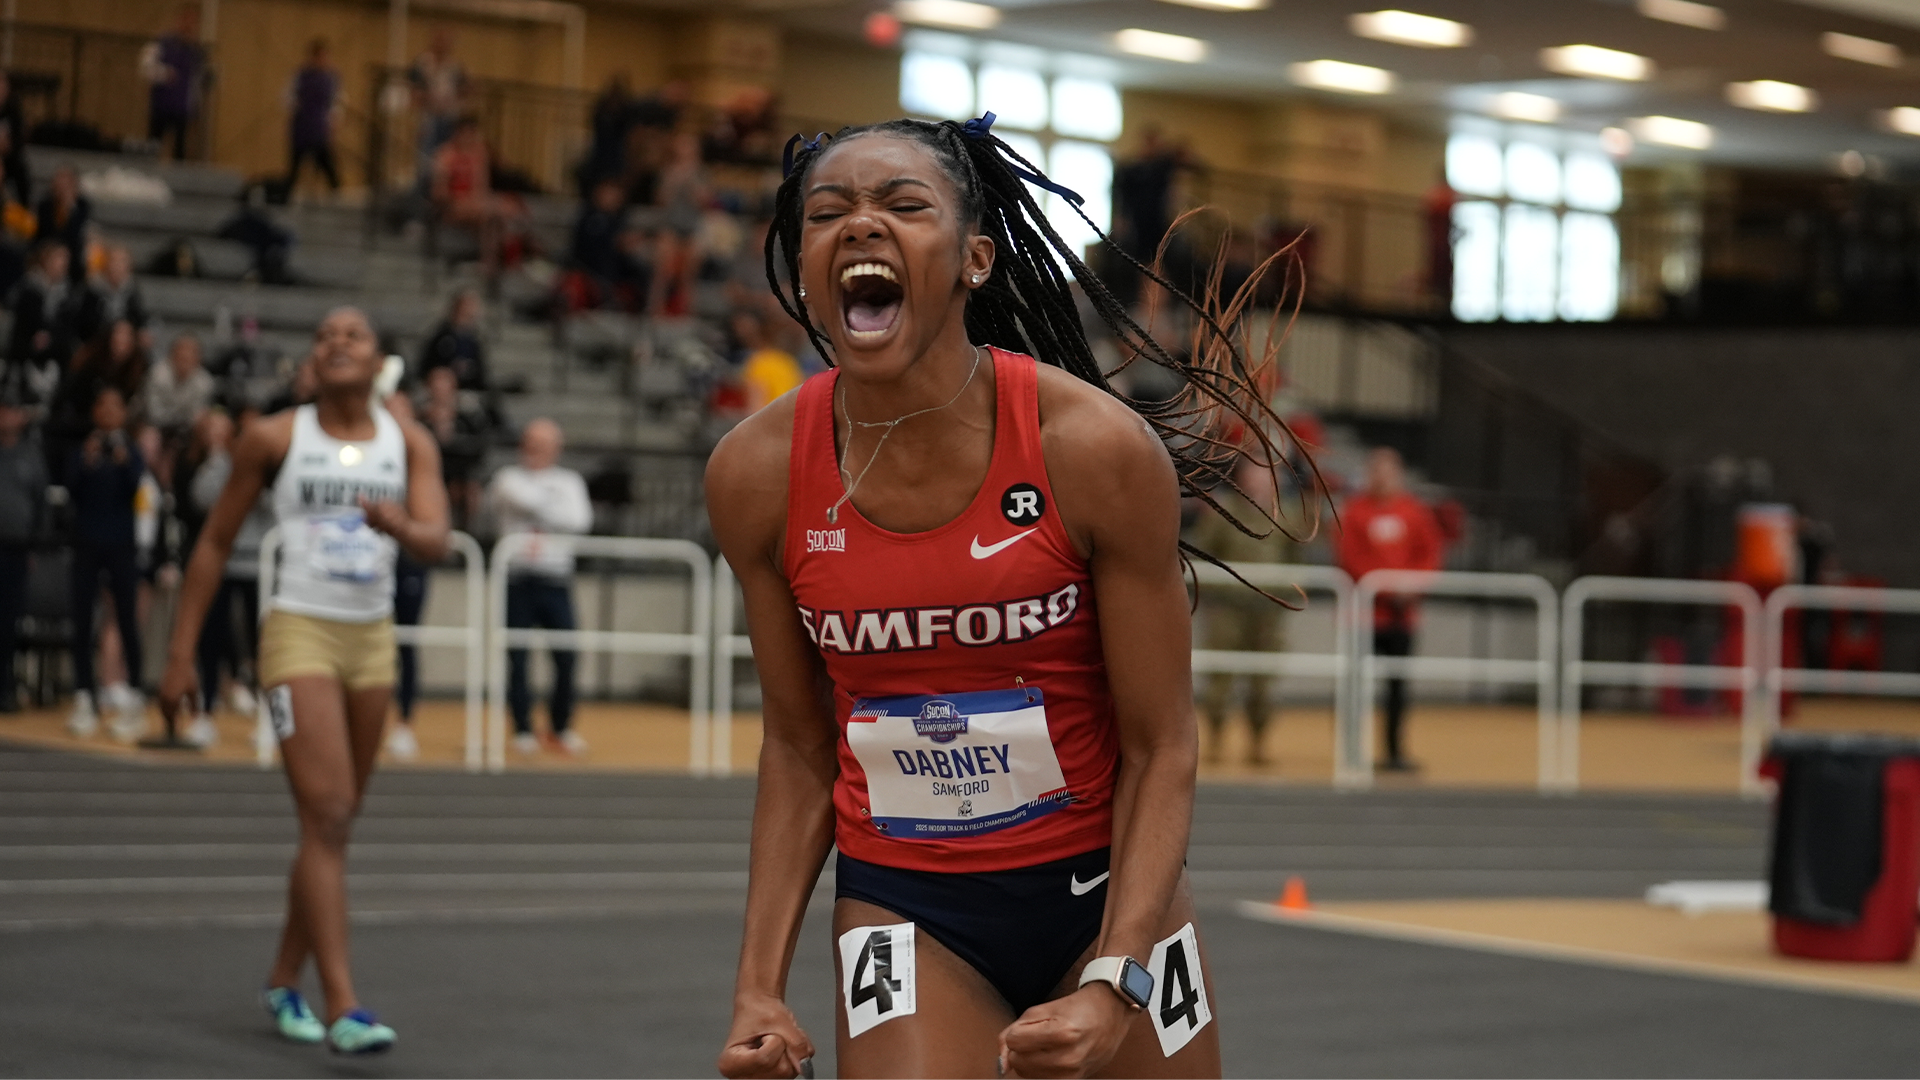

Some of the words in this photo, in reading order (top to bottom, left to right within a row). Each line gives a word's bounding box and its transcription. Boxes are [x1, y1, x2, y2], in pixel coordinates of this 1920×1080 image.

[916, 722, 966, 732] CHAMPIONSHIPS
[892, 743, 1011, 779] DABNEY
[932, 779, 990, 797] SAMFORD
[928, 824, 947, 832] INDOOR
[969, 822, 984, 831] FIELD
[984, 810, 1027, 828] CHAMPIONSHIPS
[851, 929, 902, 1015] 4
[1159, 938, 1200, 1031] 4
